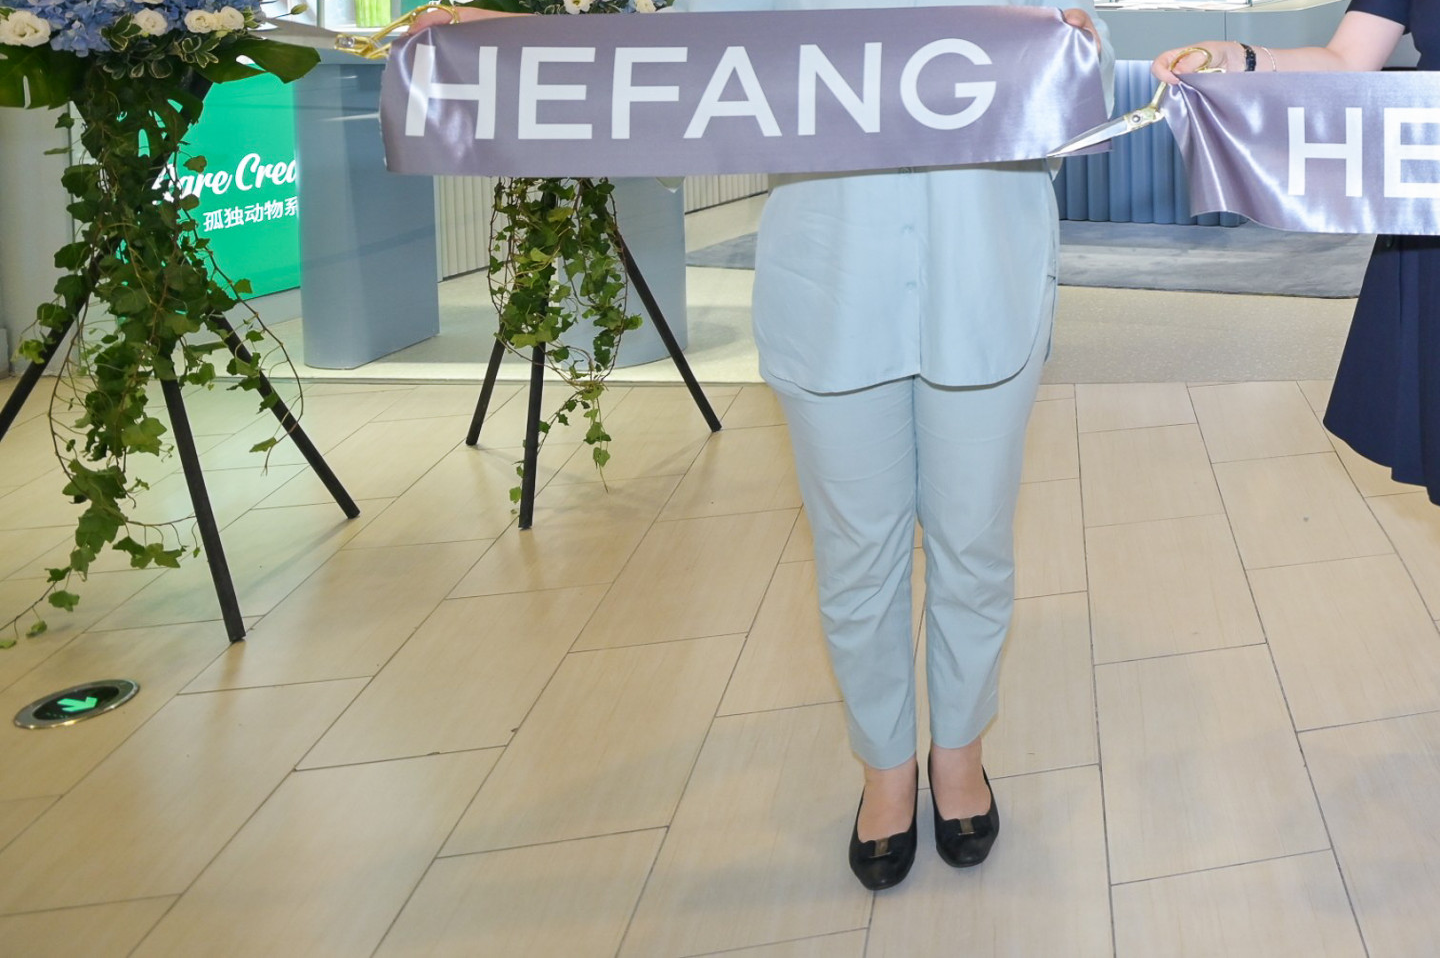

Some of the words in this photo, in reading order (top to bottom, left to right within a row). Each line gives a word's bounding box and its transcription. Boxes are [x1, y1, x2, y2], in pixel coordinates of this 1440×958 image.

[404, 37, 998, 141] HEFANG
[202, 195, 298, 232] 孤独动物系
